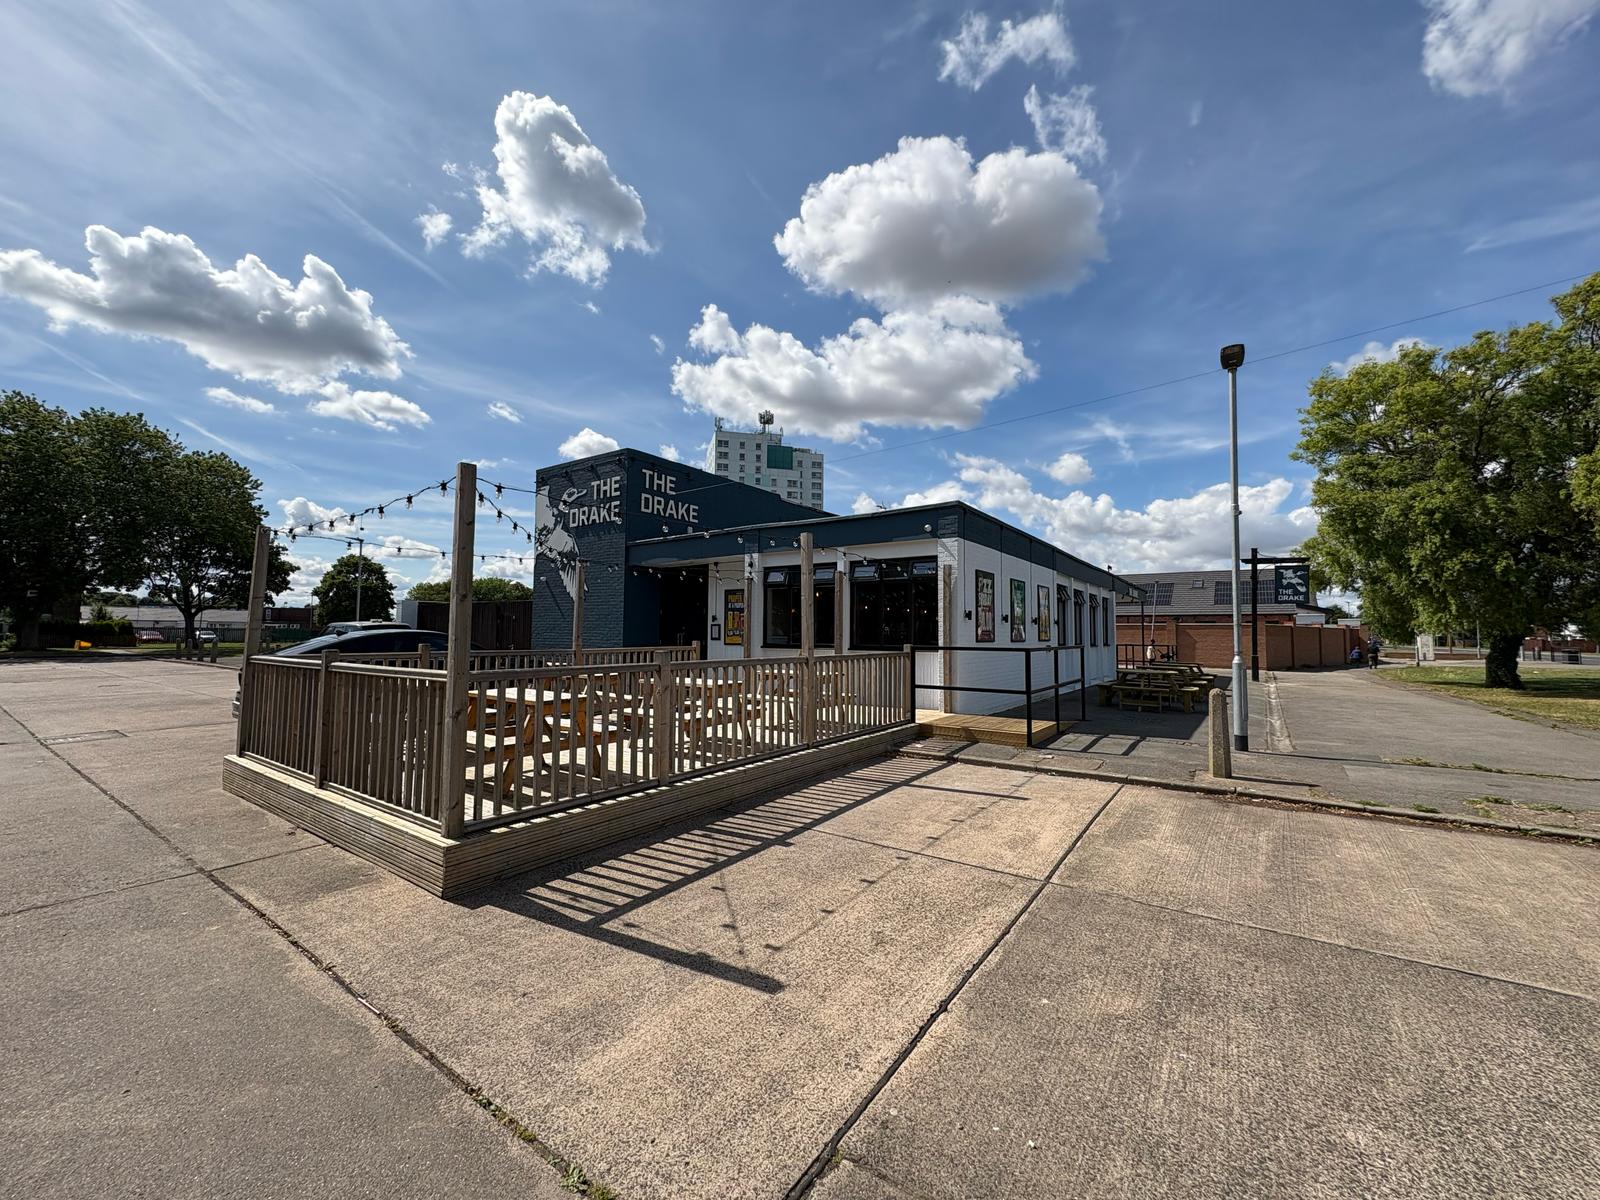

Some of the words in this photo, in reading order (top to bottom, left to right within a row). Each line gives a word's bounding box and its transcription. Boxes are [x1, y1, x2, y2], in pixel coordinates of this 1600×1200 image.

[591, 475, 621, 499] THE
[641, 468, 676, 496] THE
[569, 500, 621, 528] DRAKE
[640, 492, 699, 524] DRAKE
